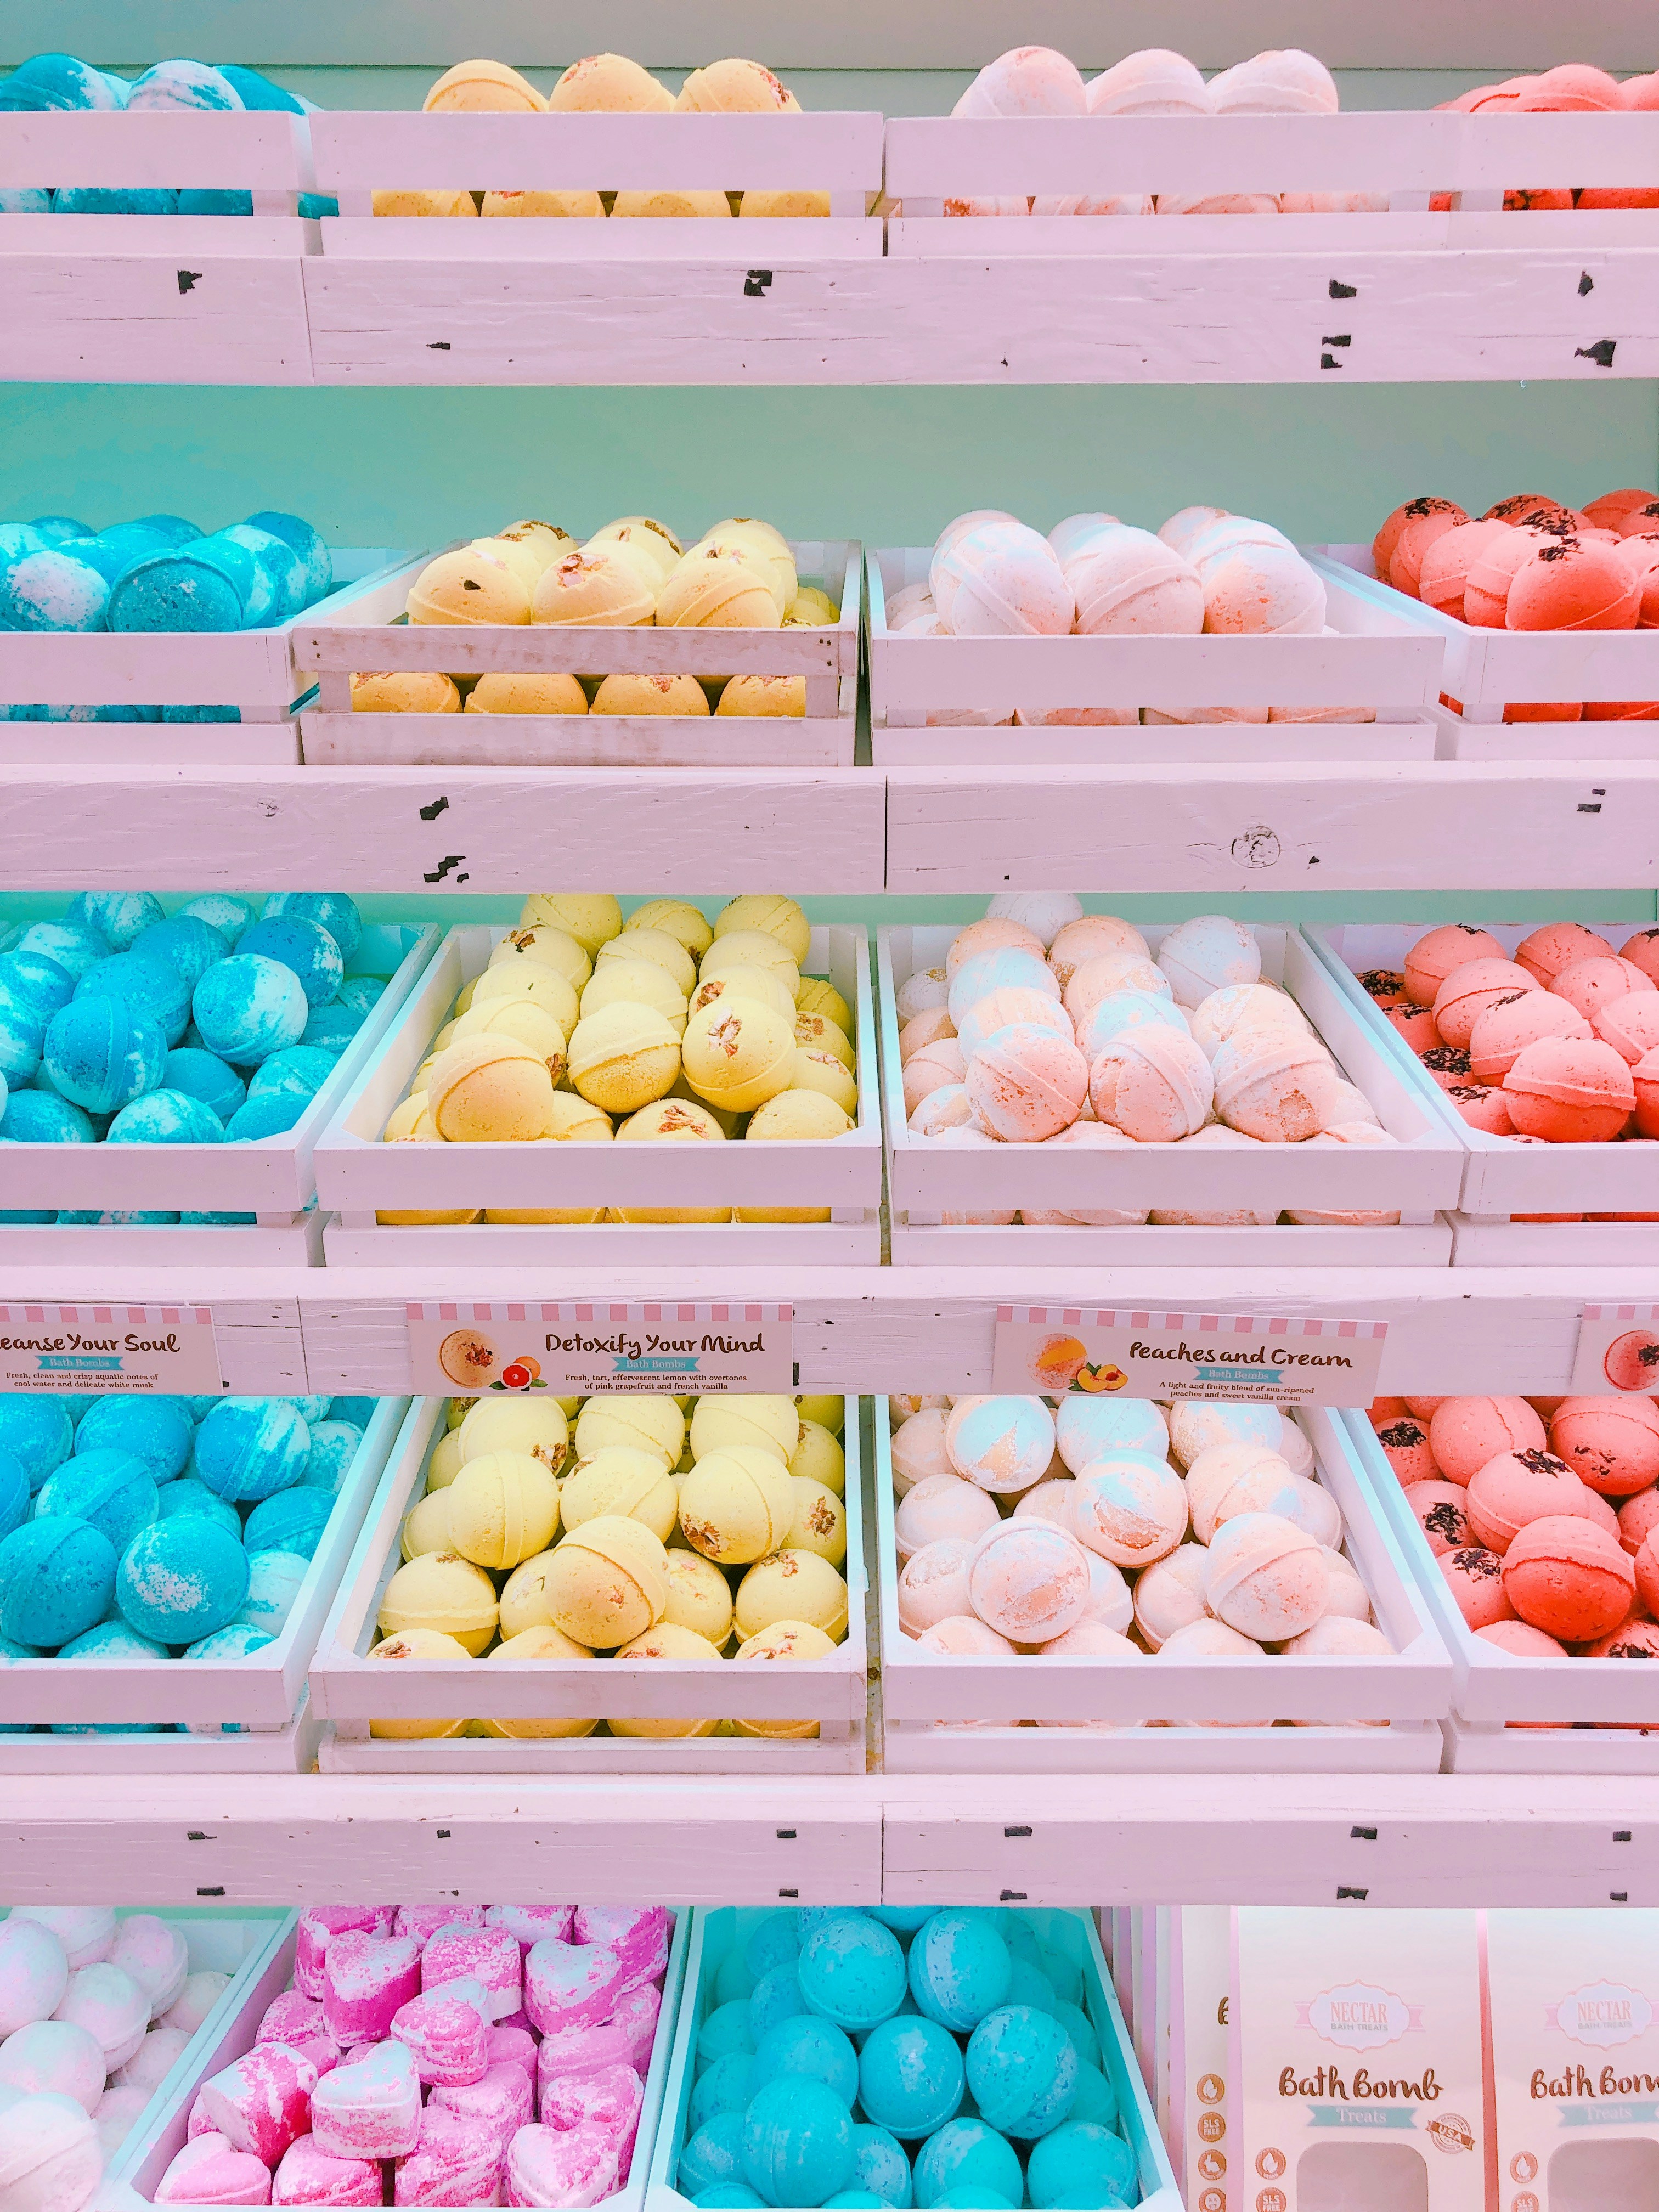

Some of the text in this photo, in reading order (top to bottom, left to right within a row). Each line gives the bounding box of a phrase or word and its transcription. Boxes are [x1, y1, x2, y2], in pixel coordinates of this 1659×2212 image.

[0, 1333, 180, 1352] eanse Your Soul
[545, 1332, 766, 1361] Detoxify Your Mind
[1130, 1341, 1353, 1368] Peaches and Cream
[50, 1358, 110, 1368] Bath Bombs
[627, 1359, 686, 1368] Bath Bombs
[74, 1373, 93, 1381] crisp
[95, 1373, 124, 1381] aquatic
[565, 1374, 590, 1382] Fresh,
[1208, 1368, 1269, 1379] Bath Bombs
[595, 1383, 613, 1391] pink
[615, 1383, 654, 1391] grapefruit
[1168, 1381, 1187, 1390] light
[1206, 1383, 1229, 1392] fruity
[1266, 1386, 1314, 1396] sun-ripened
[1330, 2001, 1388, 2023] NECTAR
[1578, 2000, 1632, 2021] NECTAR
[1279, 2064, 1444, 2101] Bath Bomb
[1530, 2064, 1659, 2100] Bath Bom
[1337, 2108, 1387, 2123] Treats
[1585, 2106, 1632, 2120] Treats
[1203, 2118, 1220, 2128] SLS
[1203, 2128, 1220, 2136] FREE
[1438, 2124, 1462, 2143] USA
[1262, 2194, 1279, 2204] SLS
